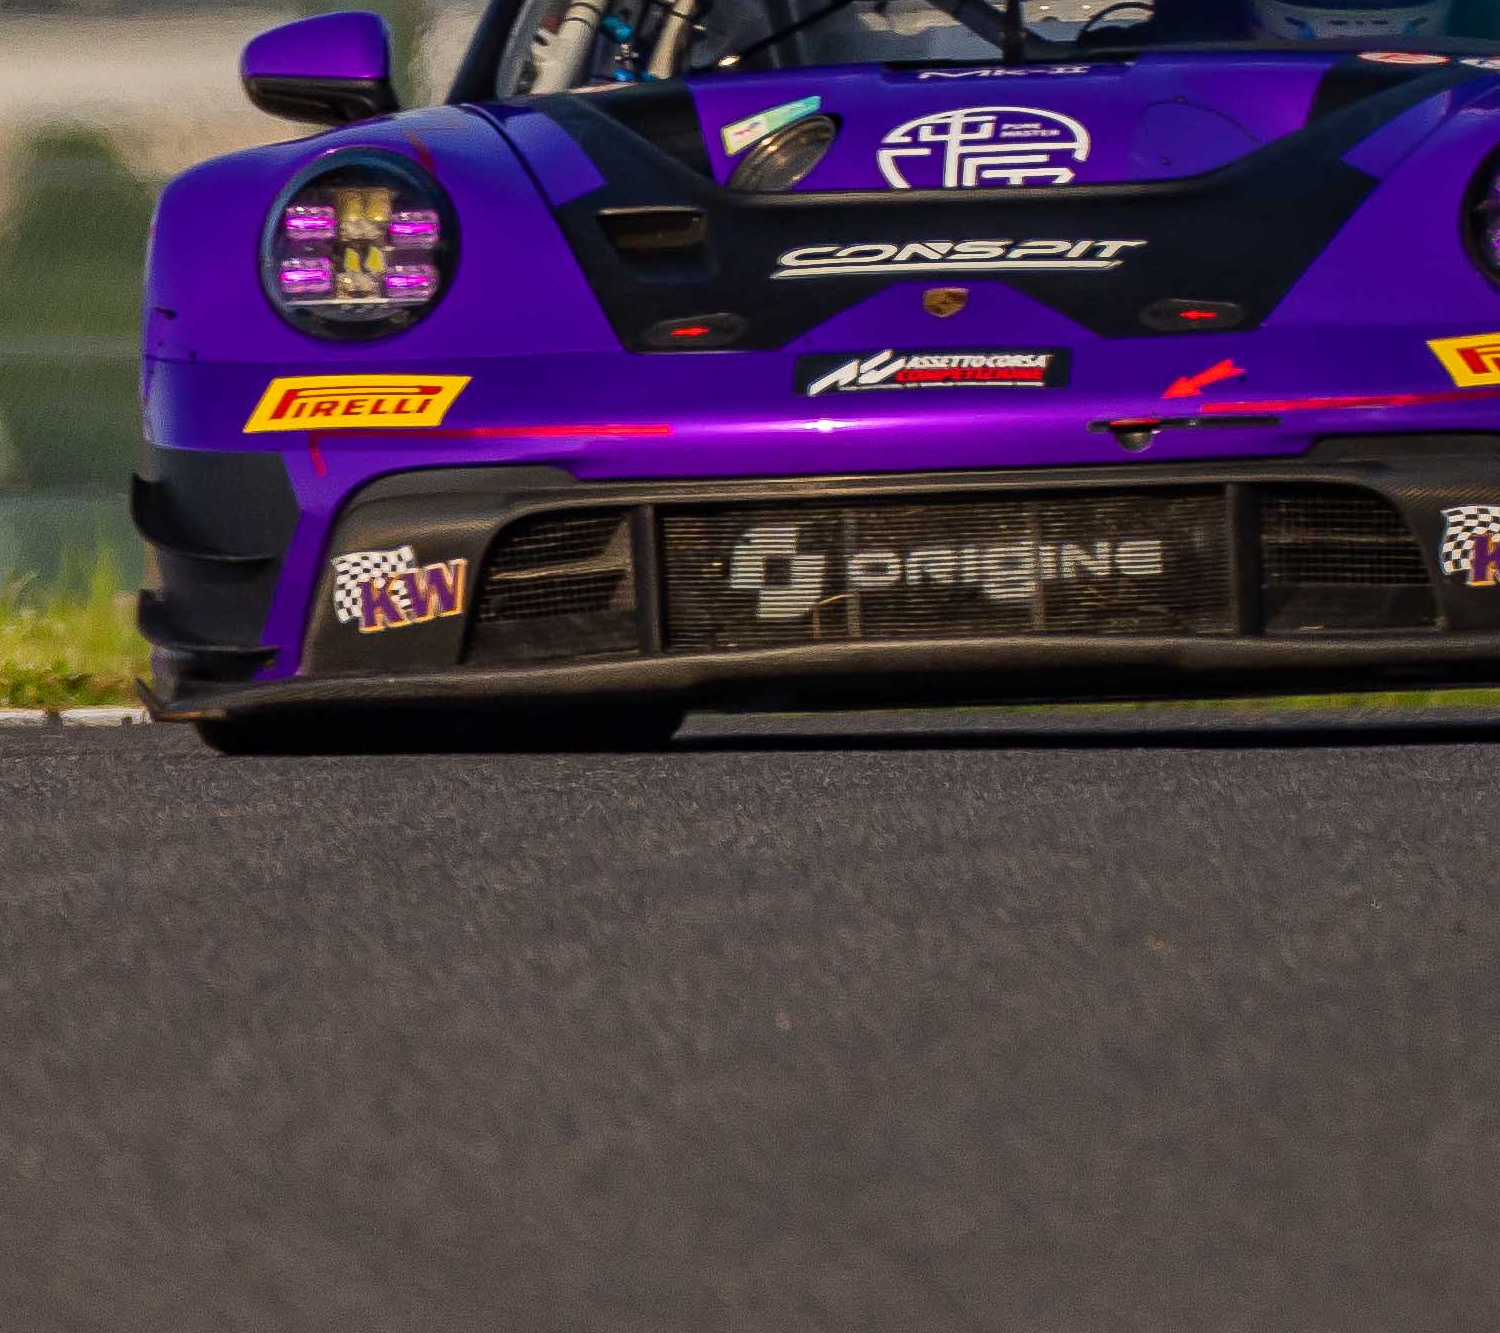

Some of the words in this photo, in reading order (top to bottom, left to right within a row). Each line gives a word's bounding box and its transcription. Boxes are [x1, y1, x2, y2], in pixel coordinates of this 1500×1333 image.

[776, 239, 1149, 268] CONSPIT
[269, 385, 443, 420] PIRELLI
[358, 558, 468, 633] KW
